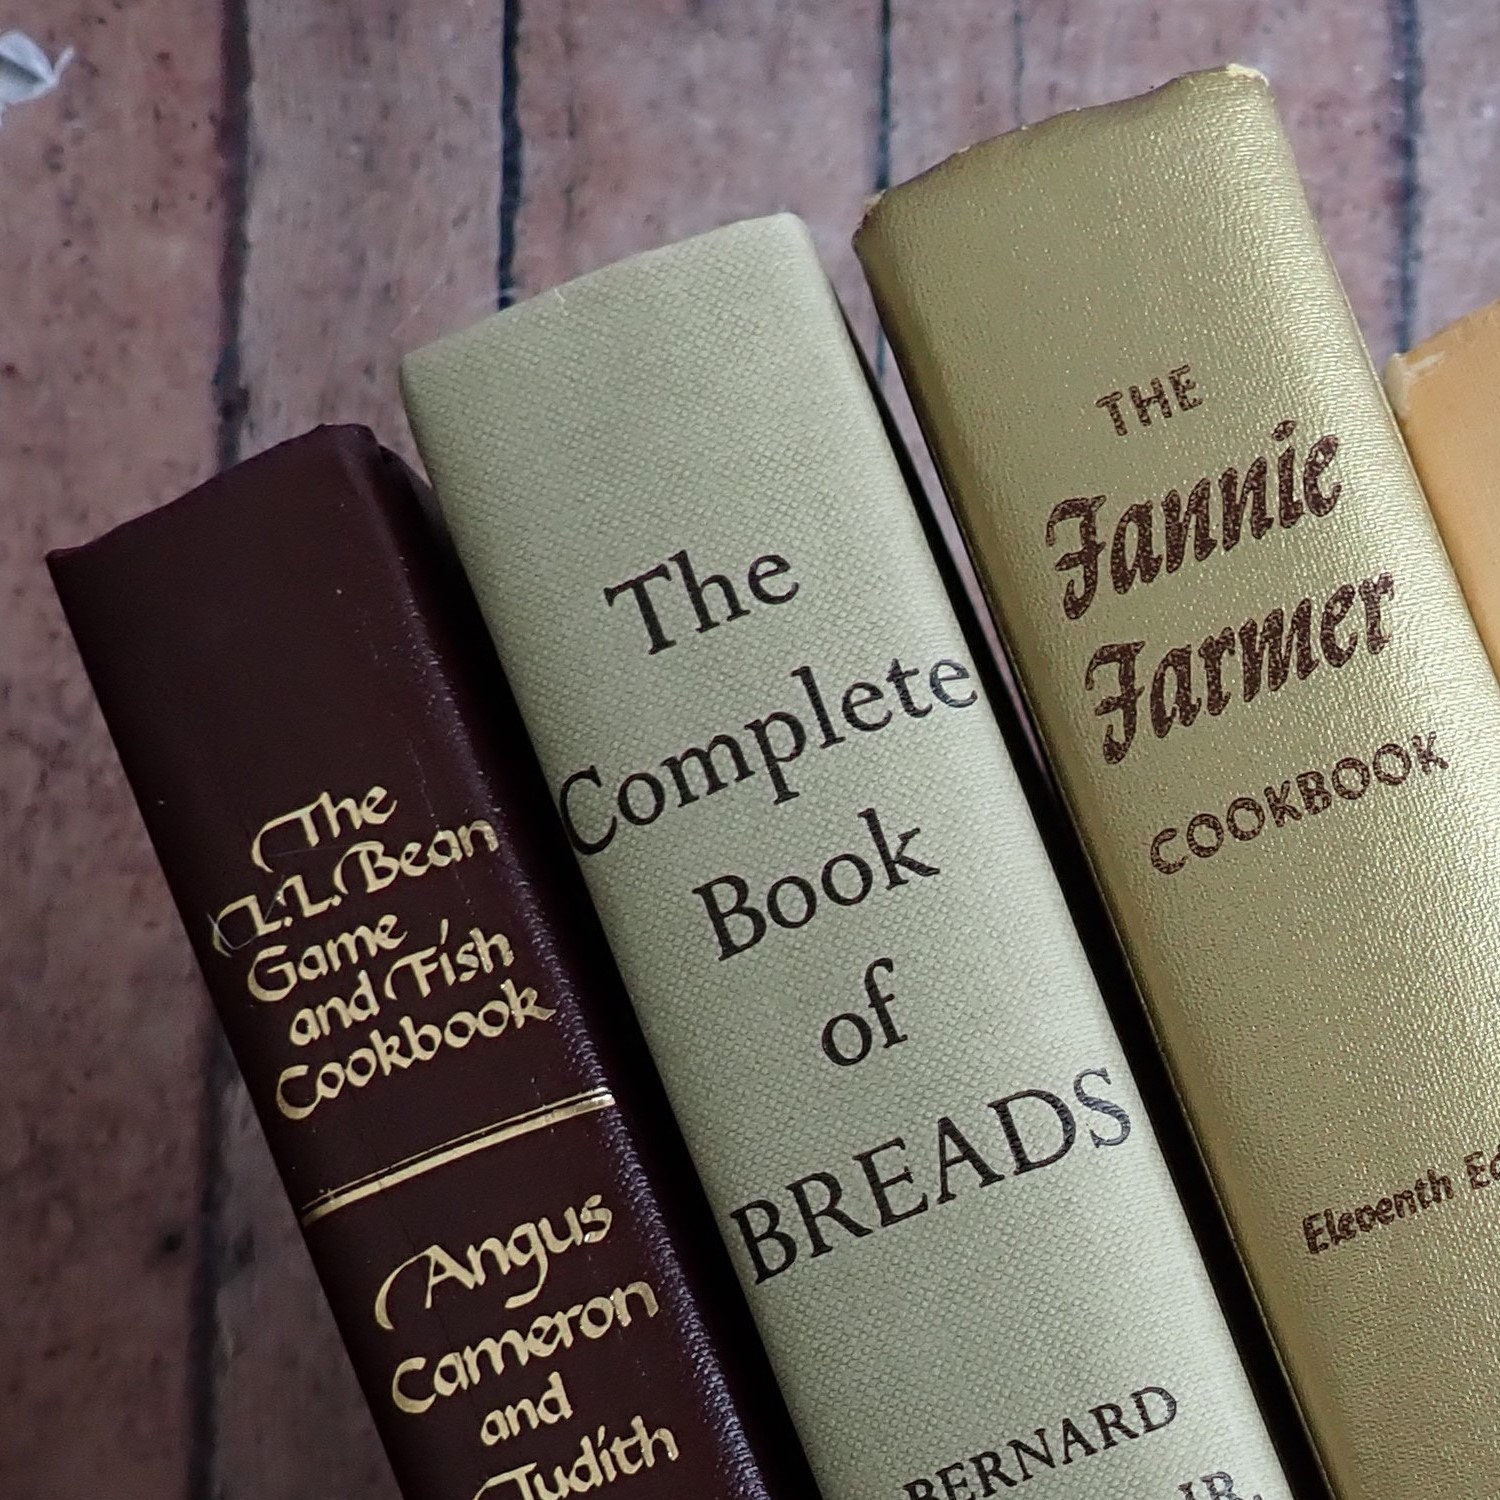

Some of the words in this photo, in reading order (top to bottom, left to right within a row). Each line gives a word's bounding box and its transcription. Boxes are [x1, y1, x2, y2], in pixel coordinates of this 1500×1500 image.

[1095, 364, 1203, 436] THE
[1045, 419, 1342, 619] Fannie
[603, 549, 800, 655] The
[1084, 572, 1395, 764] Farmer
[559, 658, 978, 856] Complete
[1150, 731, 1449, 875] COOKBOOK
[213, 874, 341, 957] L.L.
[333, 819, 500, 895] Bean
[251, 784, 398, 873] The
[692, 807, 941, 962] Book
[247, 914, 408, 1001] Game
[289, 970, 381, 1046] and
[385, 918, 515, 1000] Fish
[821, 957, 908, 1067] of
[276, 978, 557, 1121] Cookbook
[730, 1067, 1132, 1285] BREADS
[1302, 1168, 1454, 1254] Eleventh
[374, 1194, 612, 1330] Angus
[391, 1281, 660, 1413] Cameron
[480, 1371, 573, 1446] and
